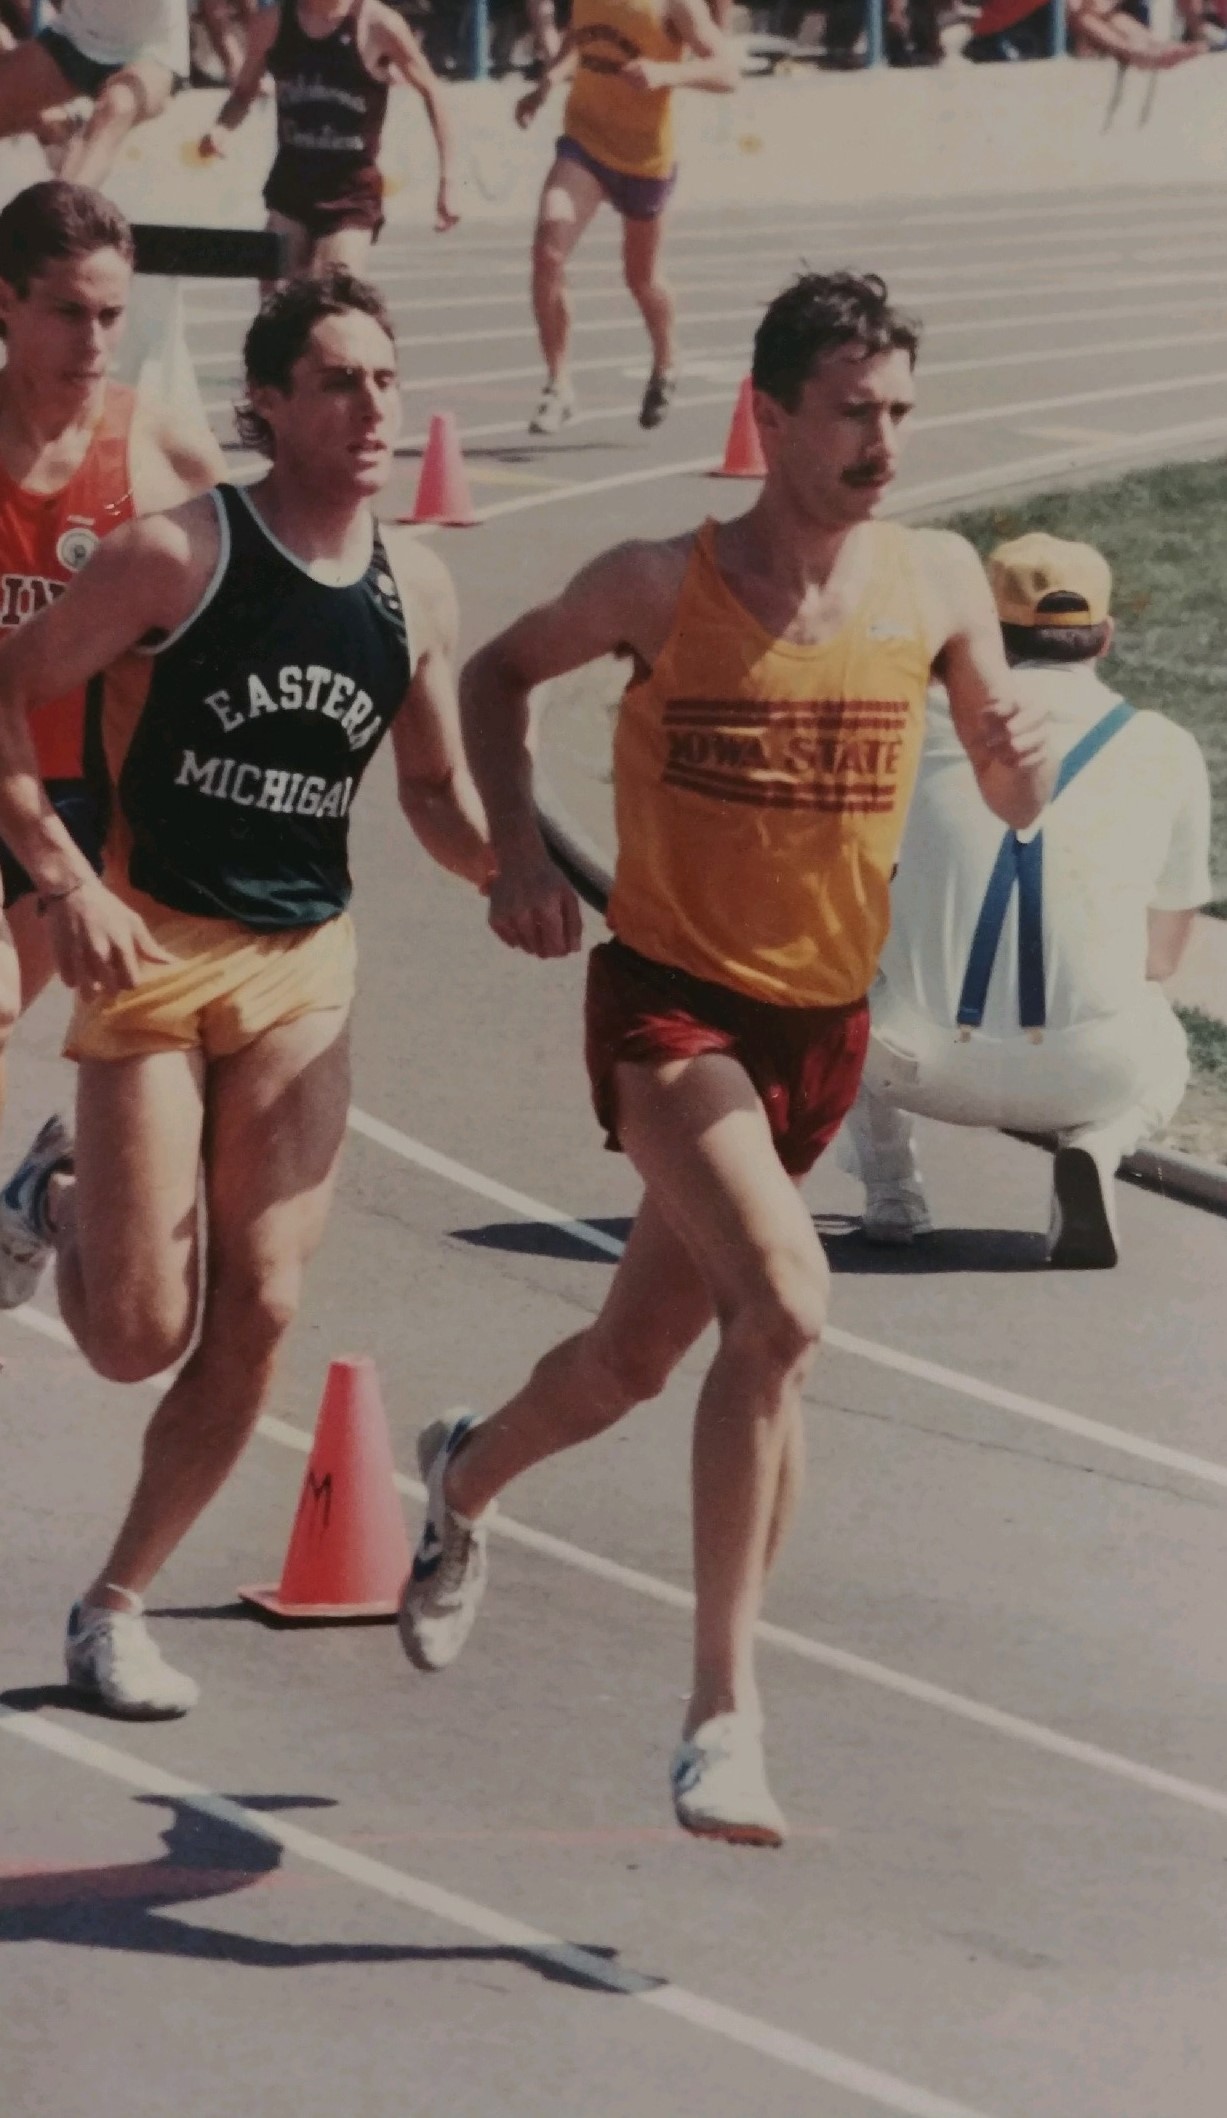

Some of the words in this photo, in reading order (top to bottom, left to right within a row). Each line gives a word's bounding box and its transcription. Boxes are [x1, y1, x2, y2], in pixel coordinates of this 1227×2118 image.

[669, 733, 769, 770] IOWA
[786, 736, 903, 775] STATE
[299, 1468, 332, 1528] M
